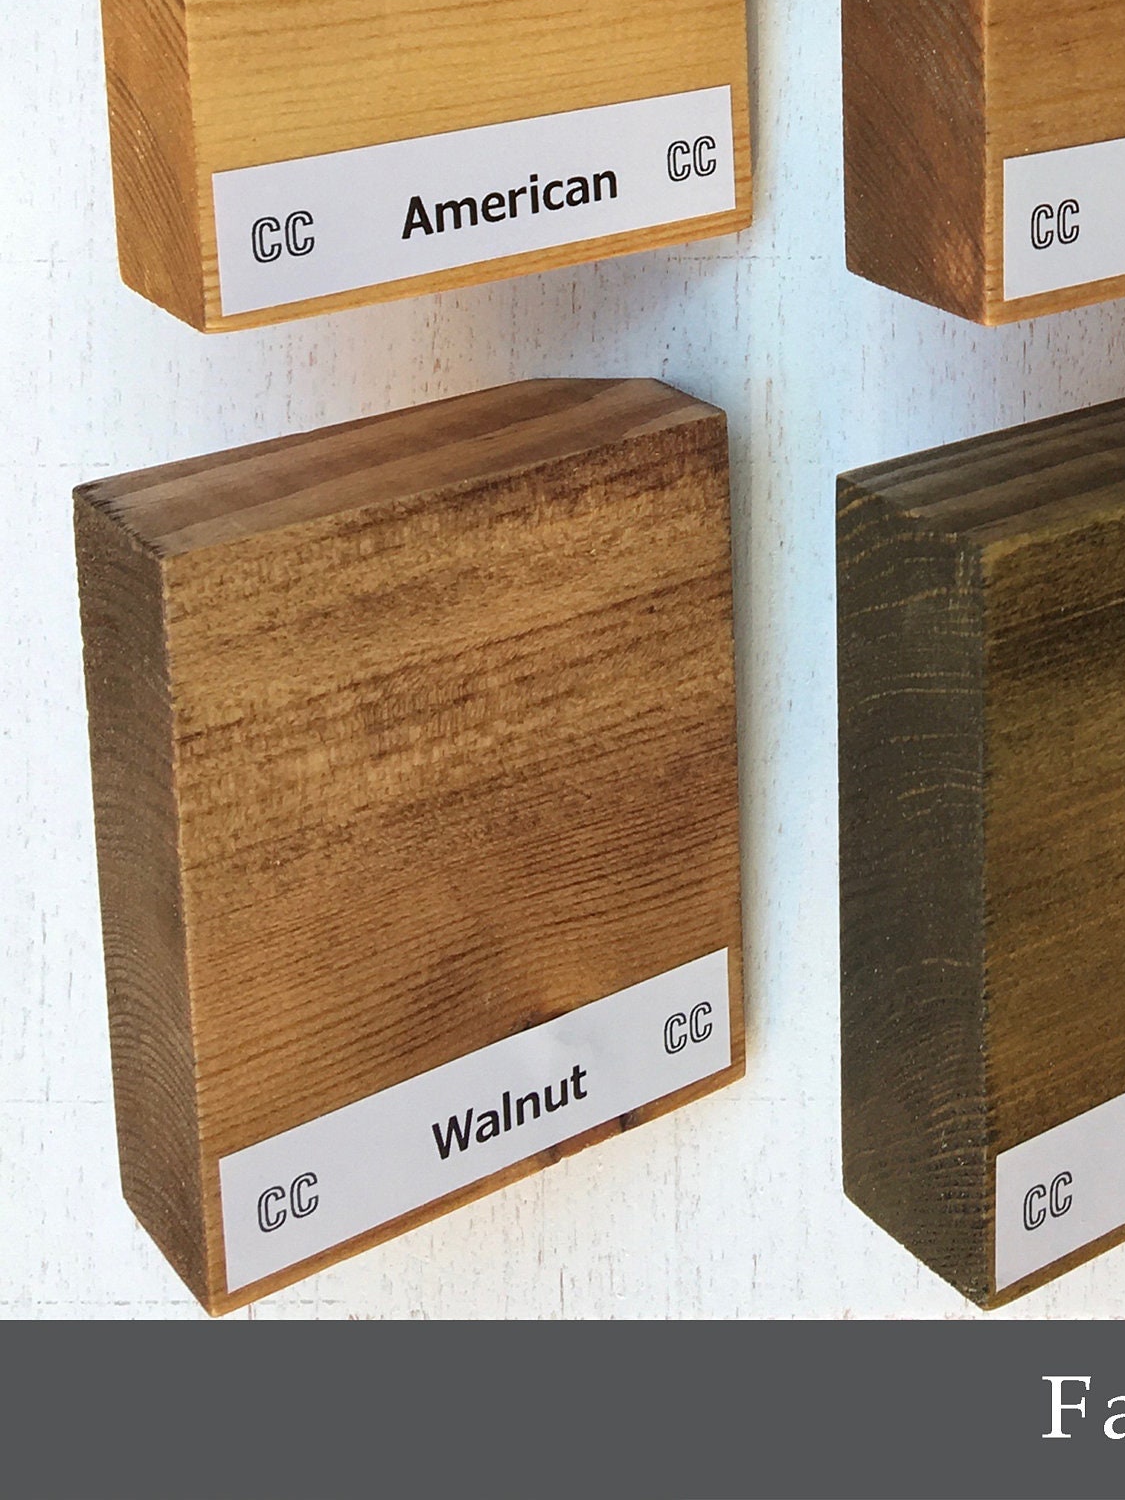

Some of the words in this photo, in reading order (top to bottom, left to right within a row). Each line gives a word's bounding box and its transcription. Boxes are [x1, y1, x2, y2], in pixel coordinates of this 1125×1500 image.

[251, 210, 316, 264] CC
[401, 170, 618, 240] American
[666, 135, 717, 183] CC
[1030, 198, 1080, 251] CC
[257, 1171, 320, 1234] CC
[431, 1064, 588, 1161] Walnut
[663, 1001, 713, 1055] CC
[1023, 1170, 1073, 1232] CC
